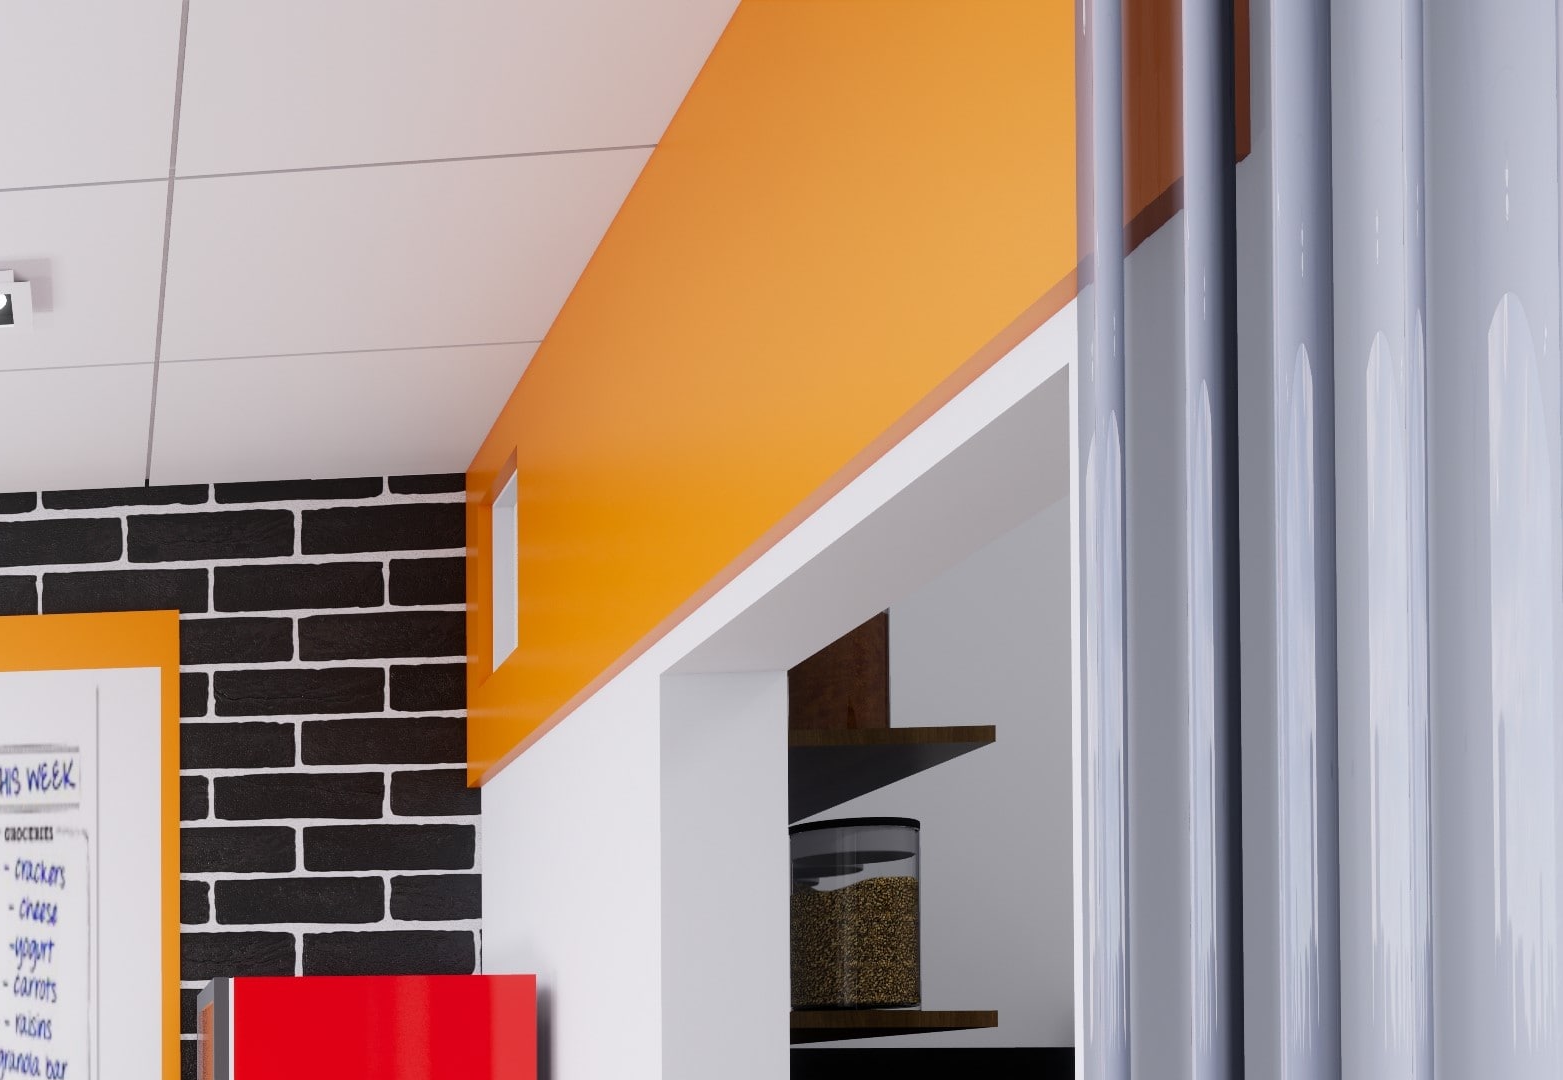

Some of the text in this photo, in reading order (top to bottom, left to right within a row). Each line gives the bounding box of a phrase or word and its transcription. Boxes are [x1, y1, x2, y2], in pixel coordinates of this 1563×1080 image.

[27, 759, 76, 793] WEEK
[4, 826, 54, 841] GROCERIES
[15, 857, 66, 890] crackers
[19, 897, 57, 926] cheese
[15, 937, 55, 973] yogurt
[13, 973, 57, 1003] carrots
